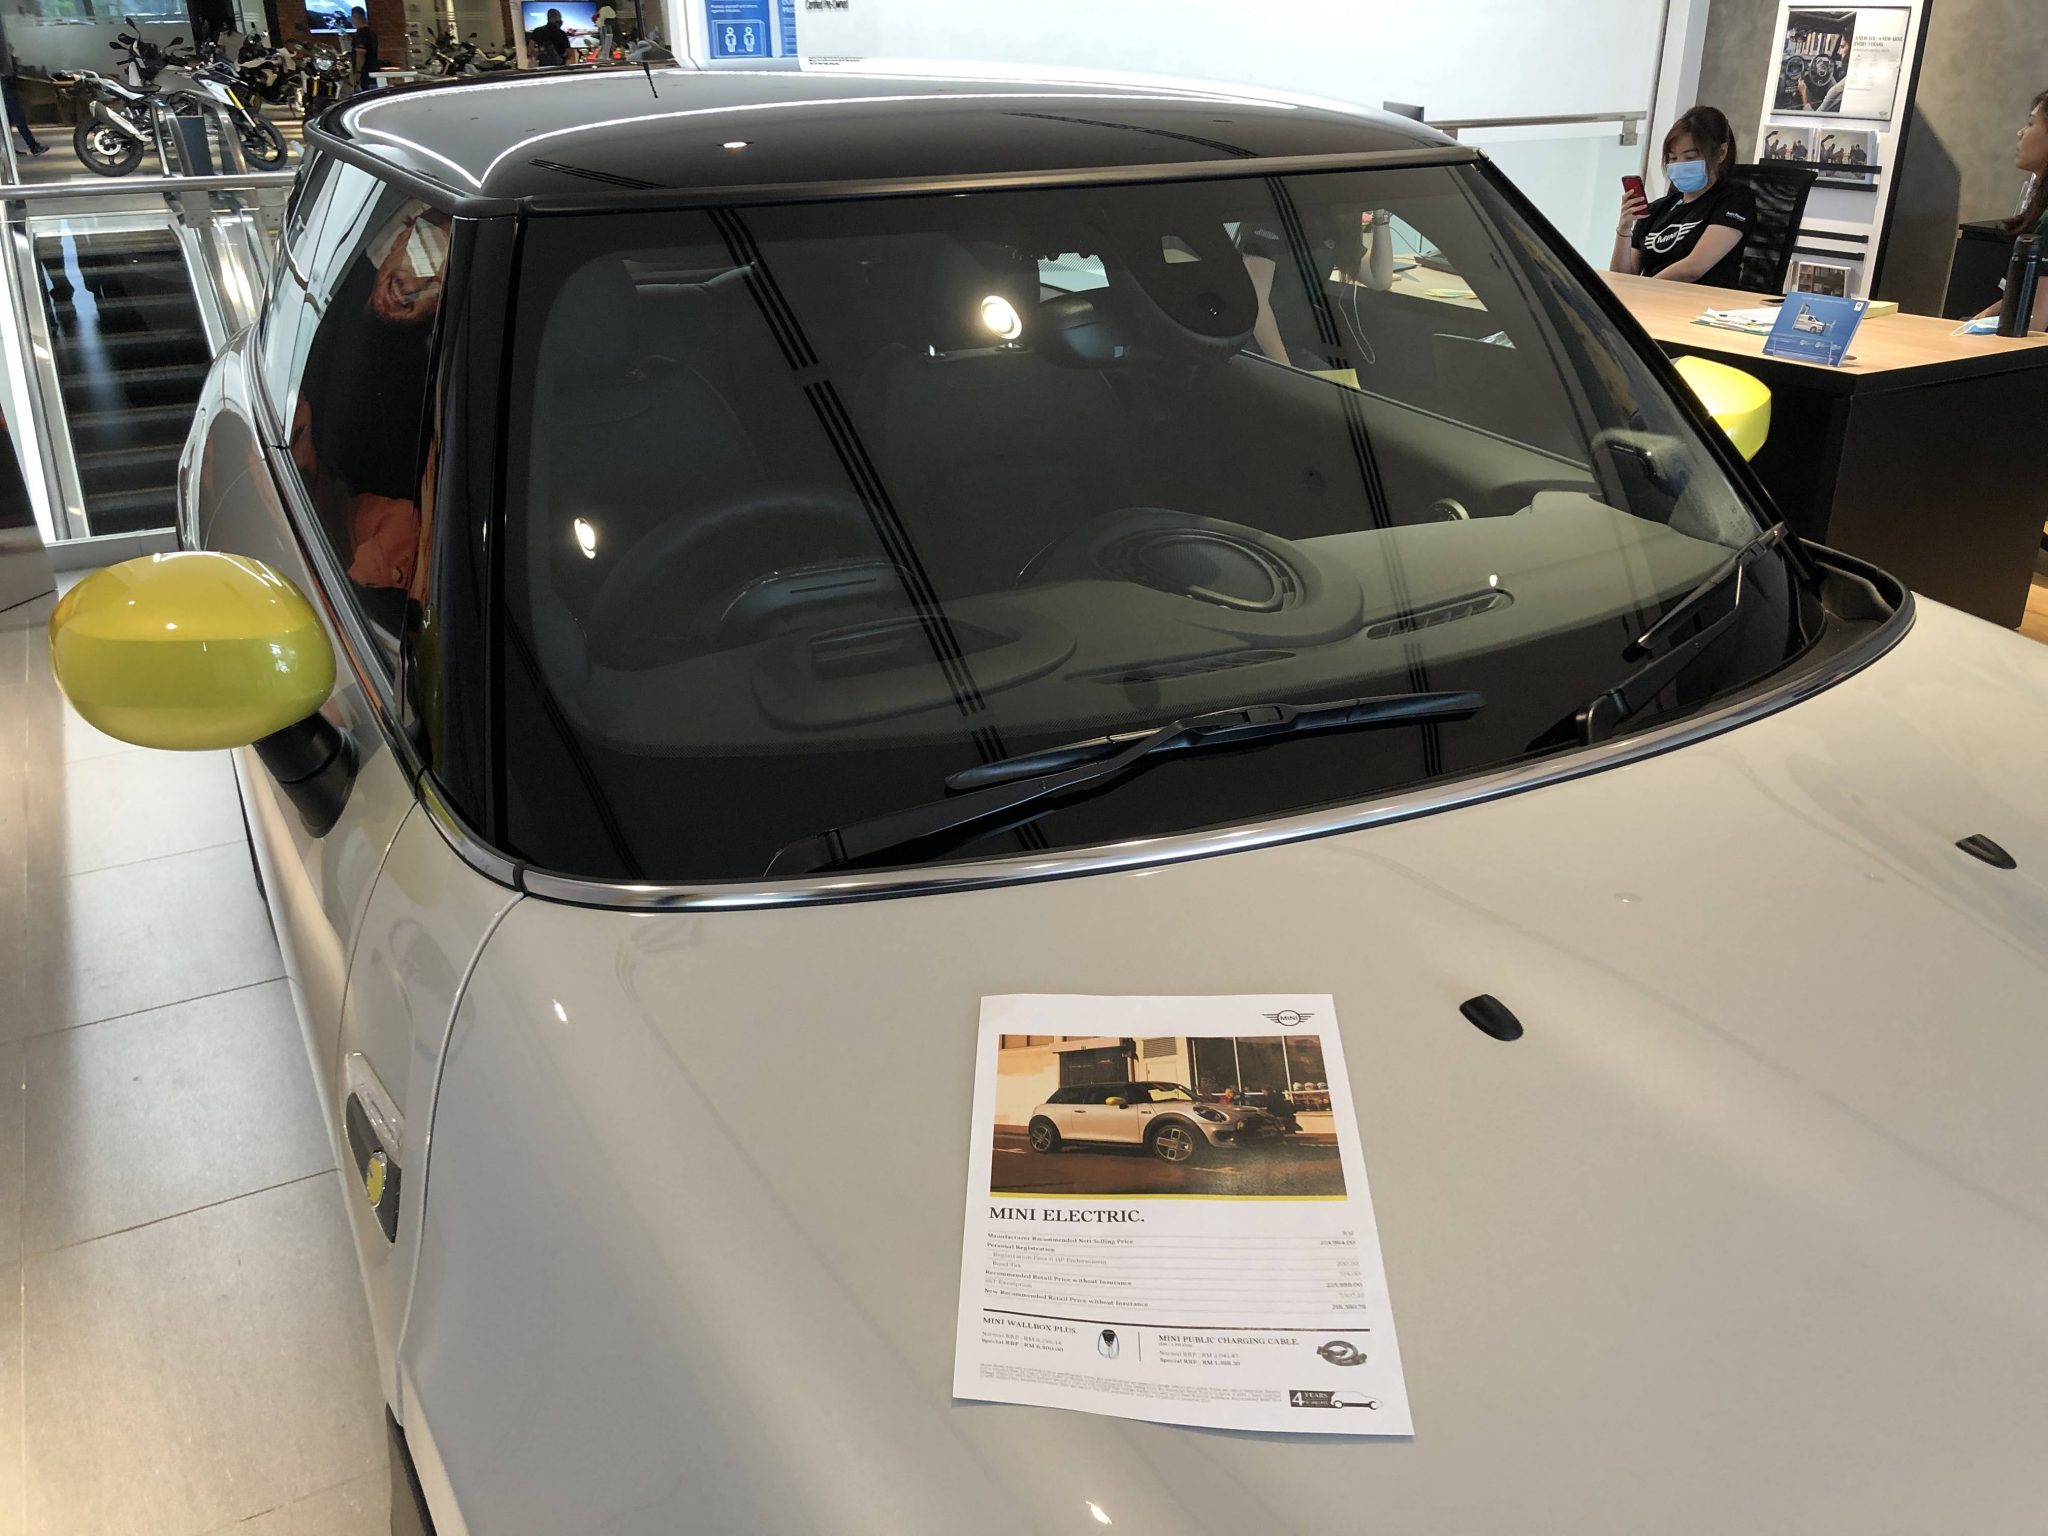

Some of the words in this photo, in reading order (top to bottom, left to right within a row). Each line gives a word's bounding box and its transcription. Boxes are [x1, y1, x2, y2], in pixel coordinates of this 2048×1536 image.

[1657, 231, 1678, 243] MINI
[989, 1207, 1036, 1220] MINI
[1043, 1210, 1144, 1223] ELECTRIC.
[987, 1233, 1030, 1241] Manufacturer
[1016, 1244, 1055, 1252] Registration
[986, 1269, 1031, 1278] Recommended
[1000, 1290, 1046, 1300] Recommended
[1007, 1320, 1051, 1332] WALLBOX
[1217, 1337, 1265, 1345] CHARGING
[1292, 1392, 1304, 1406] 4
